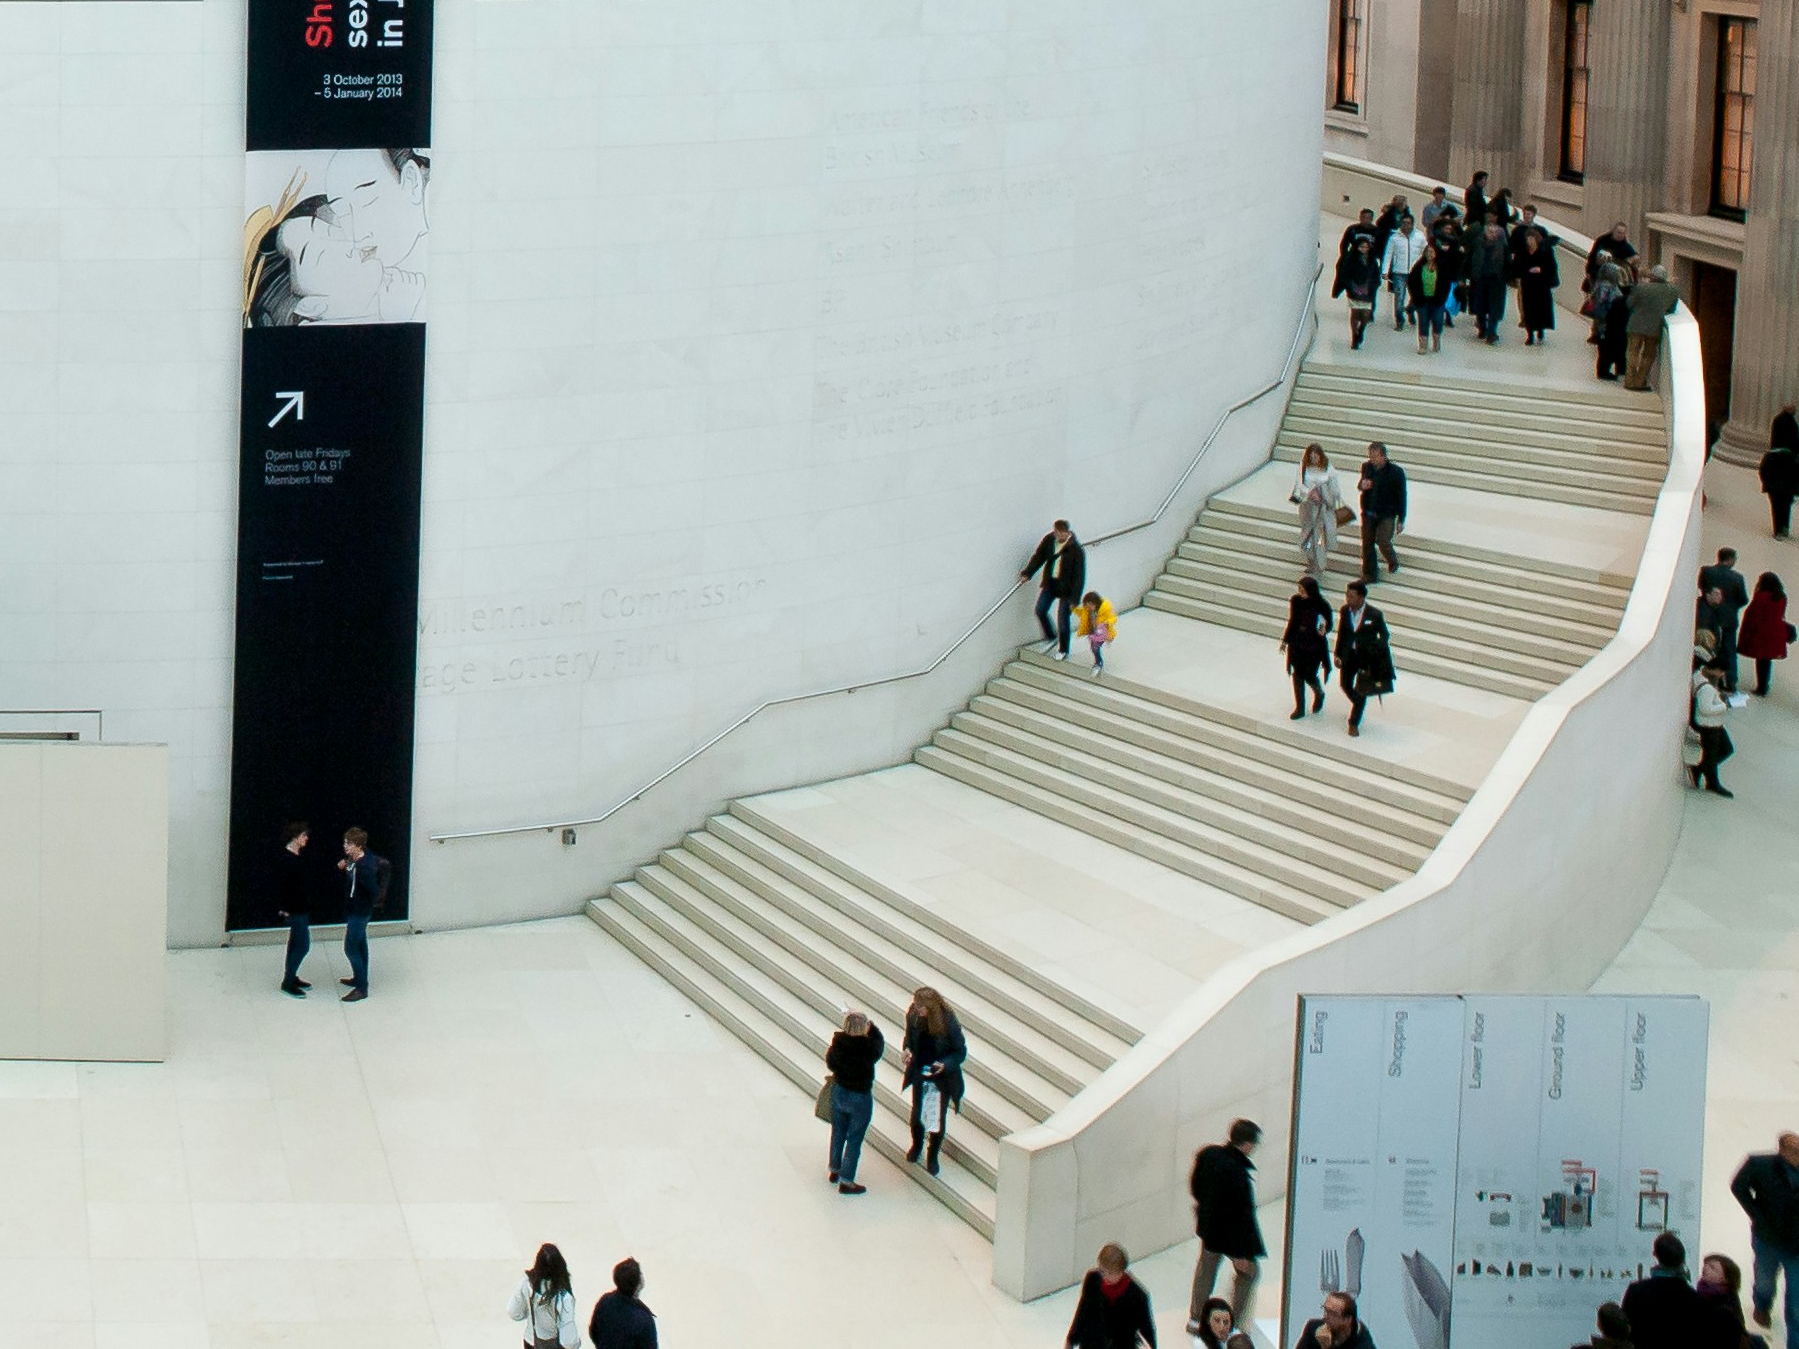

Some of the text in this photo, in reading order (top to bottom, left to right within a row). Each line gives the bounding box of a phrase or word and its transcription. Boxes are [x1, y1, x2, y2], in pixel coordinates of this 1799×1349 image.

[377, 20, 403, 47] in
[324, 74, 402, 85] 3 October 2013
[324, 87, 331, 98] 5
[334, 88, 374, 100] January
[377, 87, 402, 98] 2014
[265, 448, 350, 462] Open late Fridays
[1310, 1011, 1328, 1054] Eating
[1388, 1011, 1408, 1077] Shopping
[1468, 1012, 1484, 1089] Lower floor
[1630, 1012, 1647, 1091] Upper floor
[1548, 1012, 1565, 1099] Ground floor
